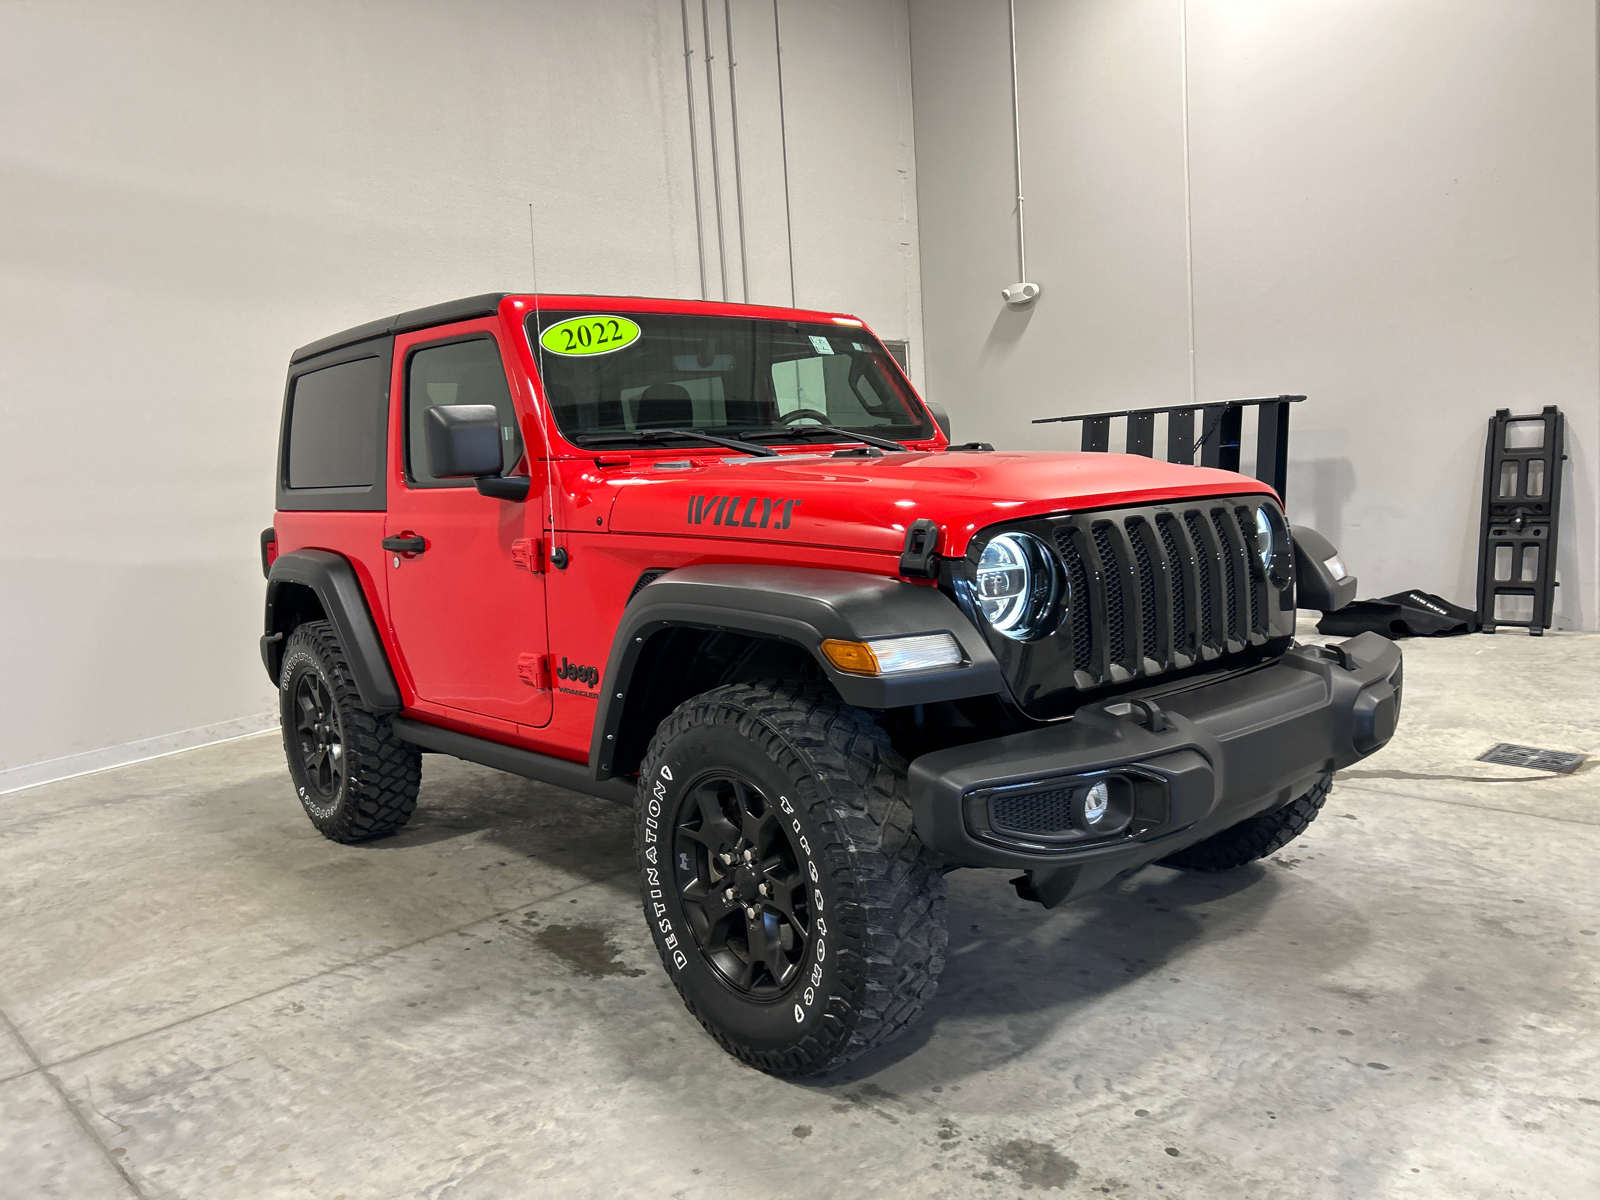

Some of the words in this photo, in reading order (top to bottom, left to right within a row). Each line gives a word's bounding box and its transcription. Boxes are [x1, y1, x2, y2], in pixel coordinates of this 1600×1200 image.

[560, 319, 623, 351] 2022
[687, 494, 802, 530] WILLYS
[556, 656, 599, 689] Jeep
[558, 686, 600, 700] WRANGLER
[645, 779, 688, 970] DESTINATION
[779, 795, 828, 1007] FIRESTONE
